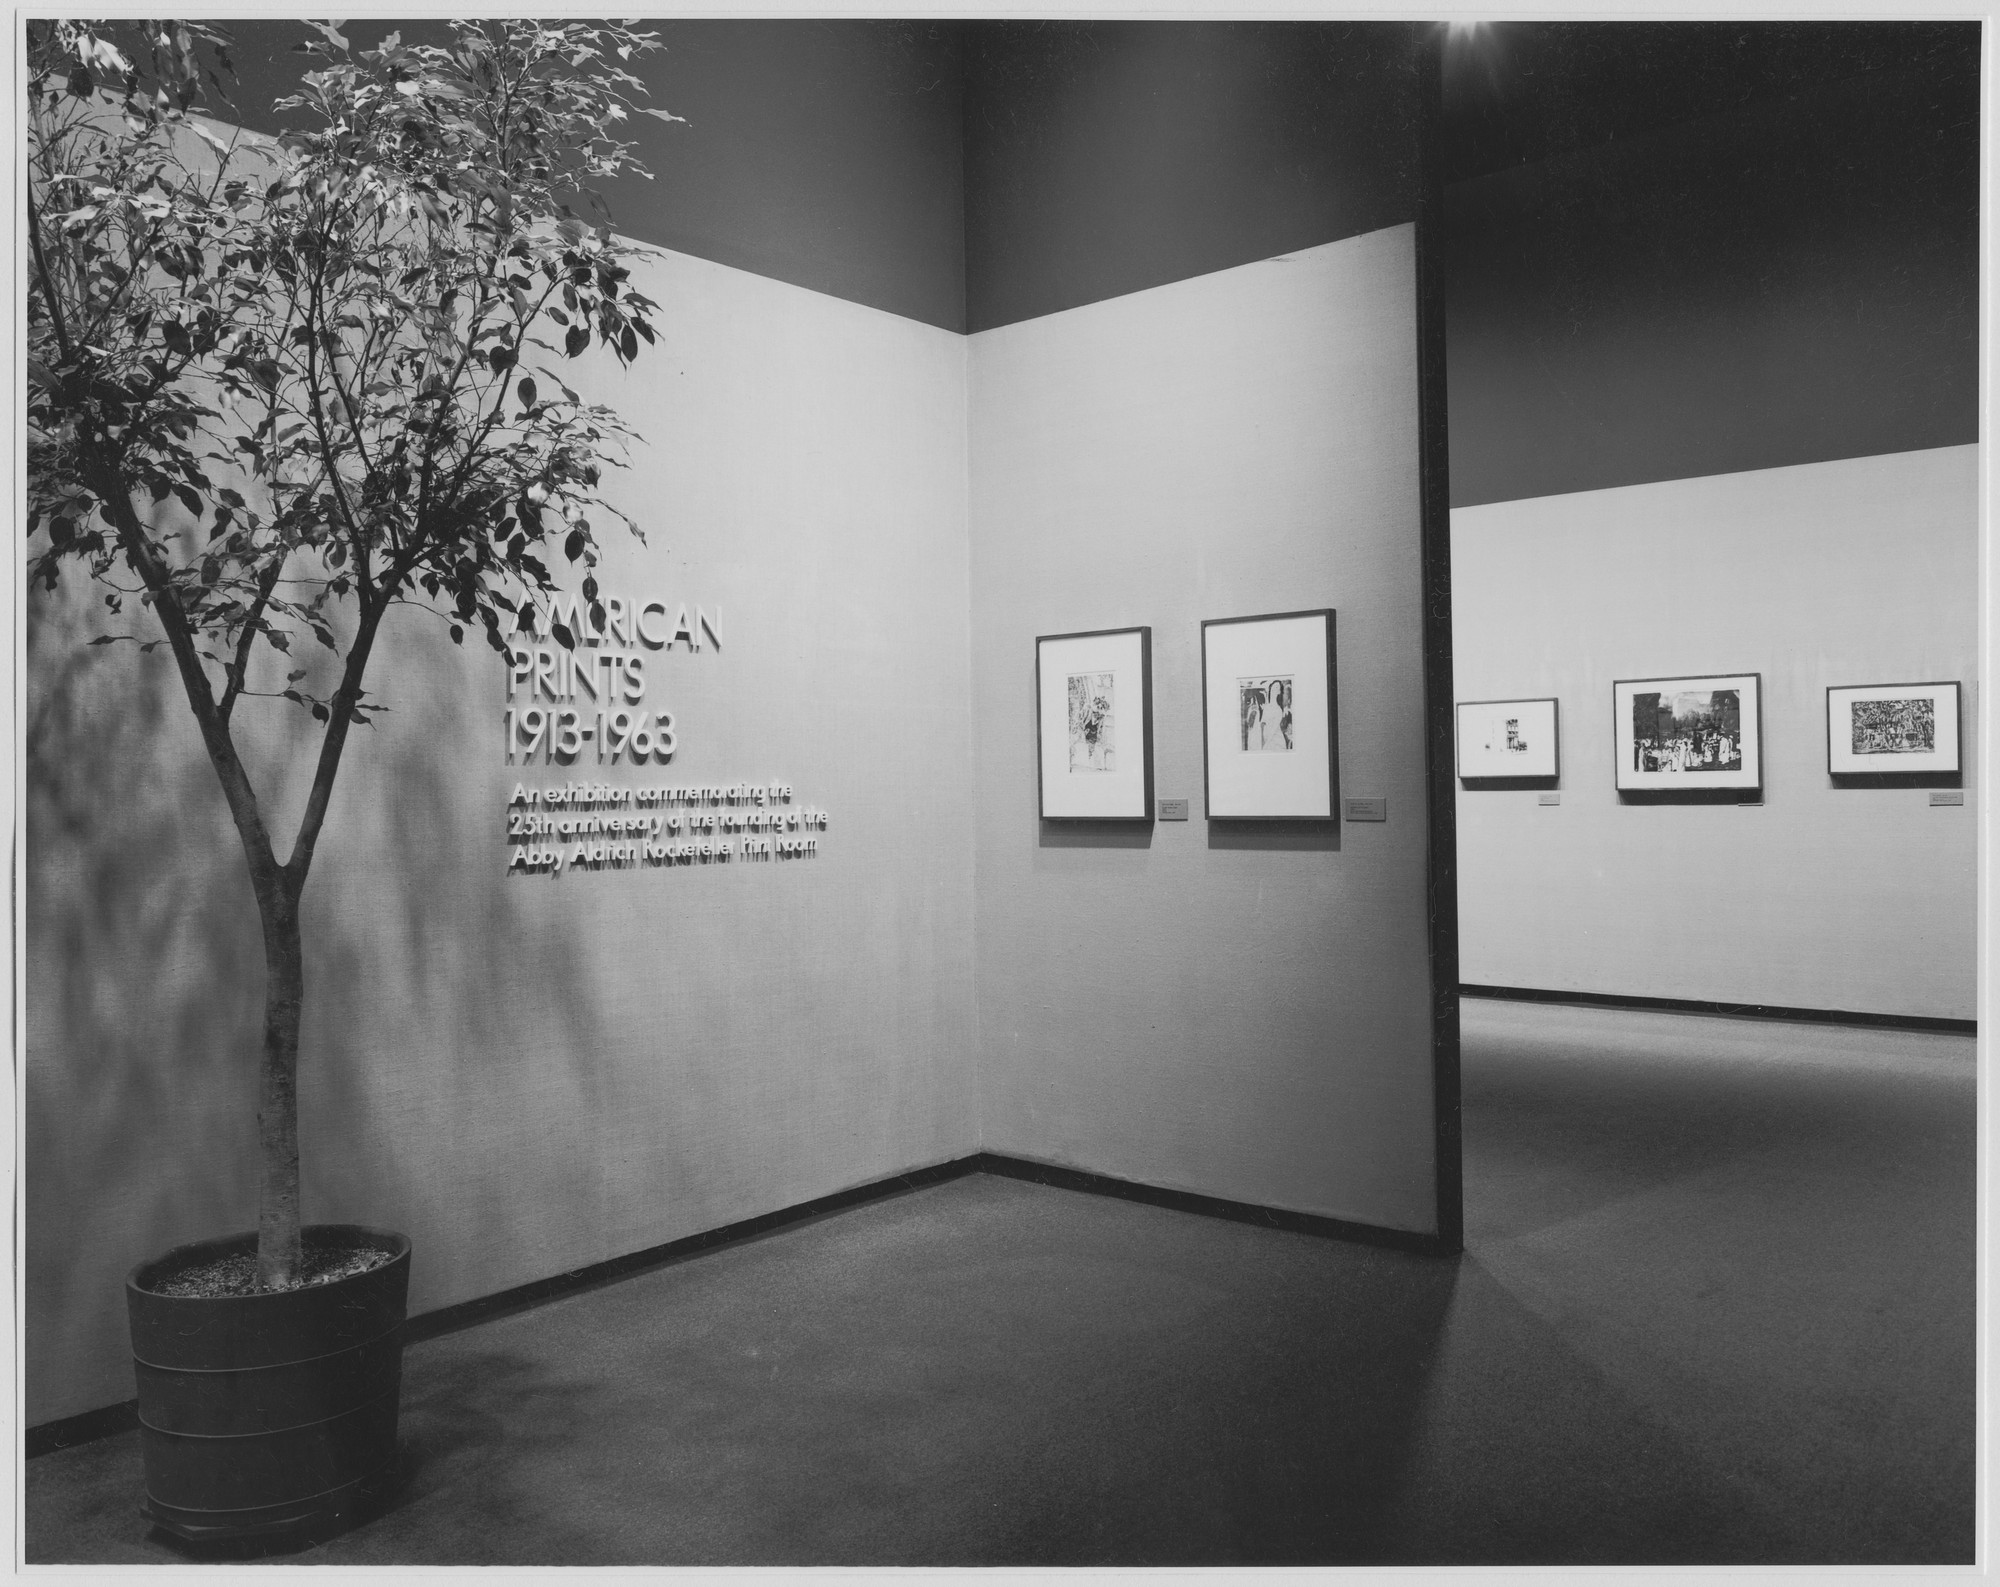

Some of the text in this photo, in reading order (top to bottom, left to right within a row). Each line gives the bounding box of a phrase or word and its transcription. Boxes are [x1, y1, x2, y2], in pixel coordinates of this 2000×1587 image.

[510, 647, 645, 698] PRINTS
[507, 708, 677, 755] 1913-1963
[510, 778, 792, 803] An exhibition commemorating the
[510, 804, 828, 835] 25th anniversary of the founding of the
[510, 833, 817, 870] Abby Aldrich Rockefeller Print Room
